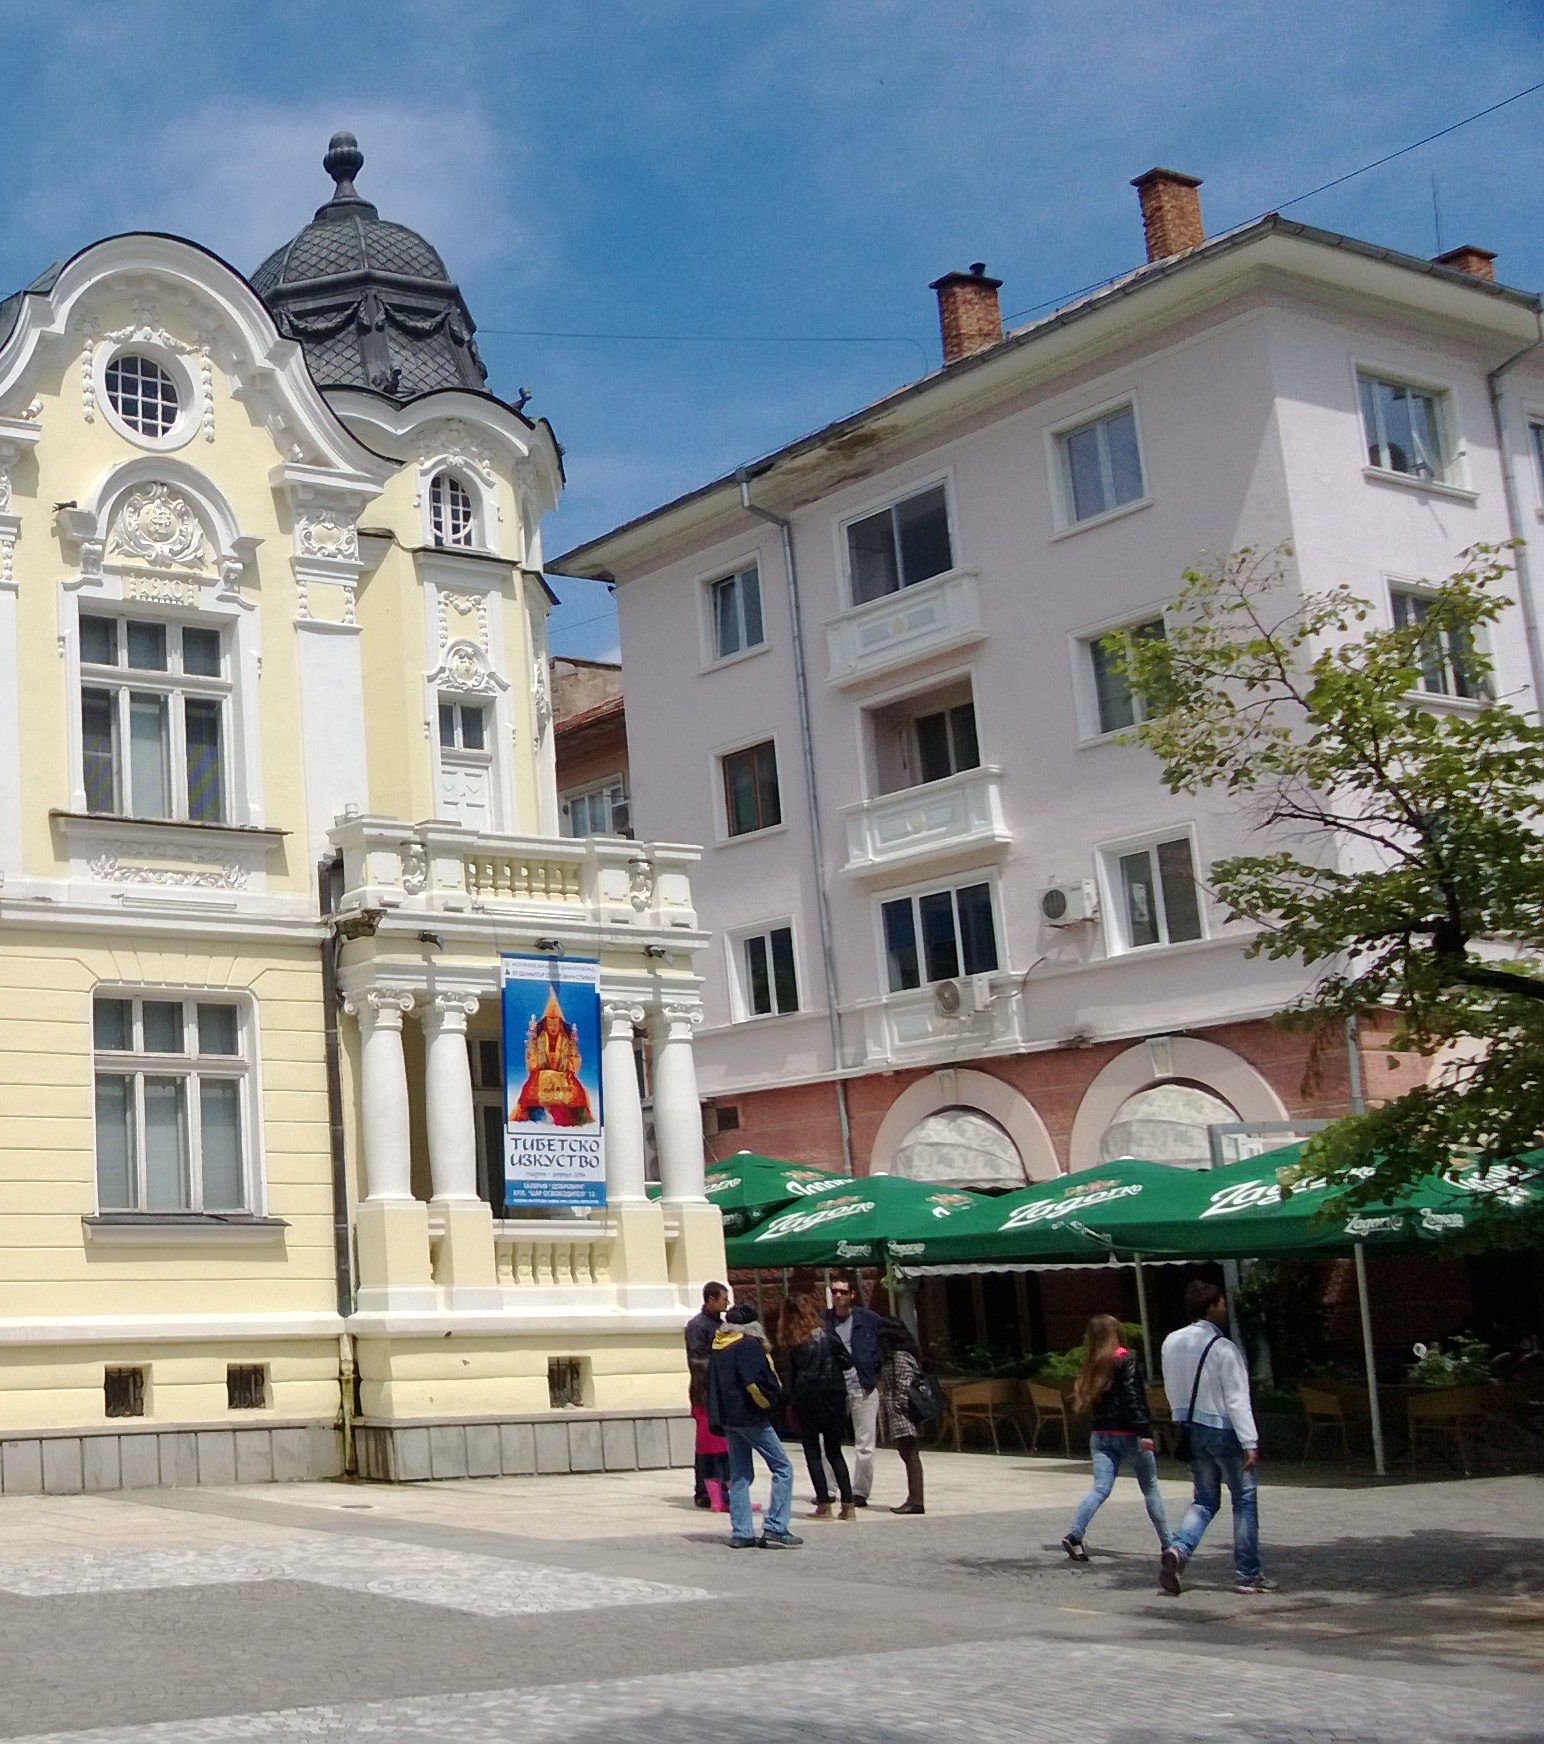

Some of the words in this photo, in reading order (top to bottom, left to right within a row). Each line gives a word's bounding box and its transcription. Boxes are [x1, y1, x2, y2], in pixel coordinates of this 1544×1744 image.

[140, 577, 183, 599] 1910
[510, 1138, 599, 1152] ТИБЕТСКО
[510, 1154, 599, 1168] ИЗКУСТВО
[997, 1183, 1144, 1232] Zagorka
[754, 1201, 876, 1243] Zagorka
